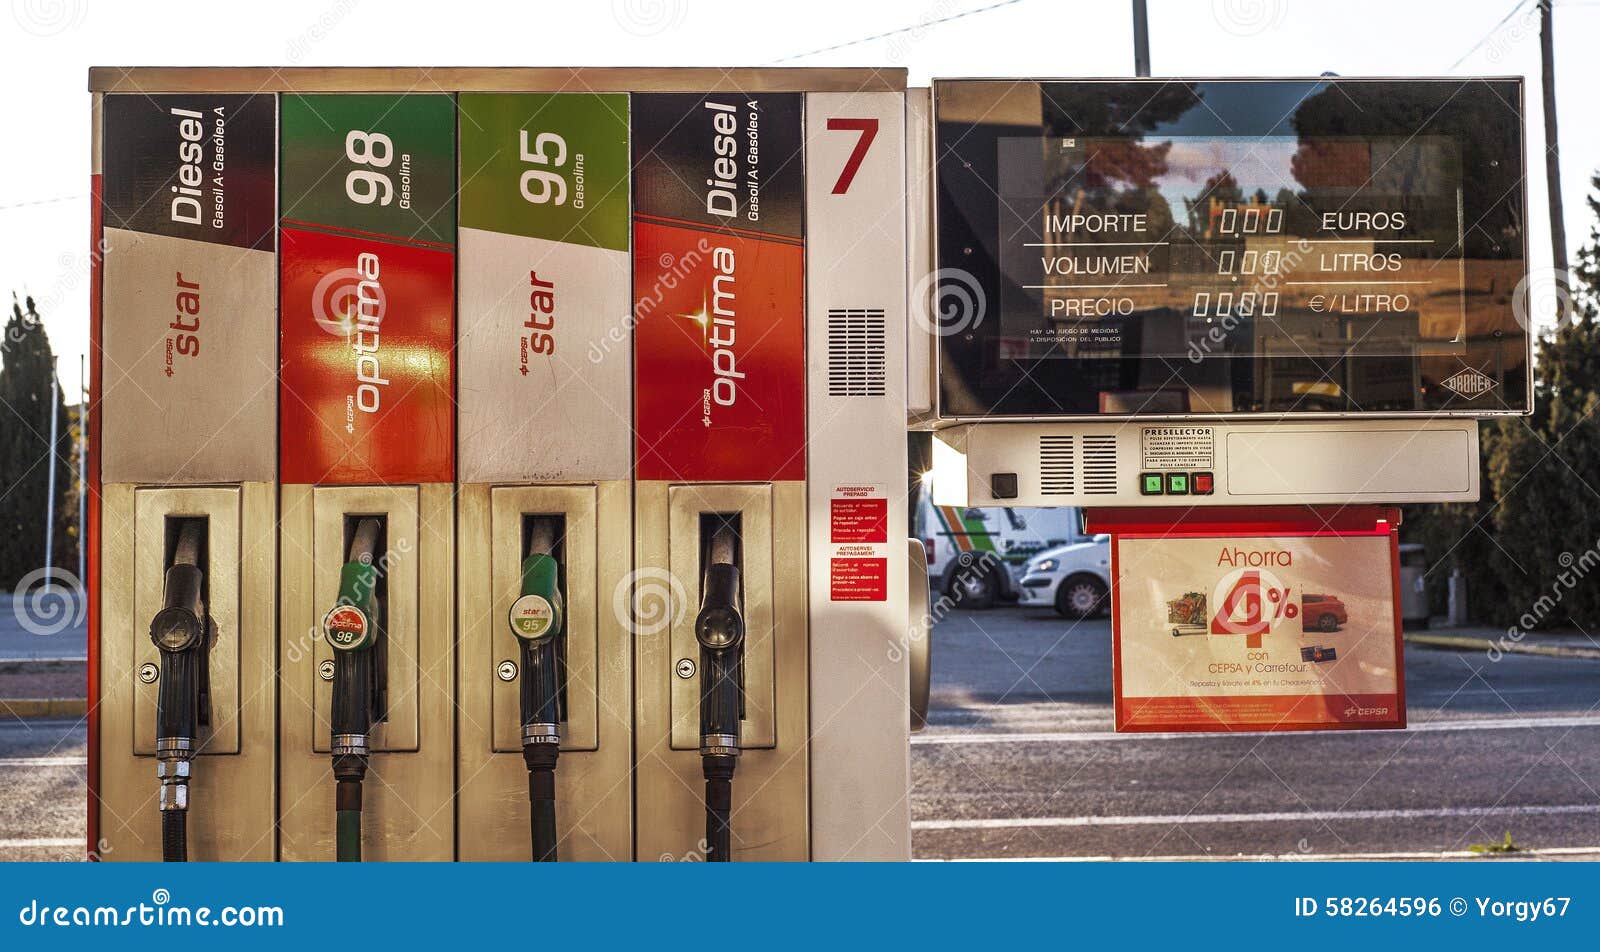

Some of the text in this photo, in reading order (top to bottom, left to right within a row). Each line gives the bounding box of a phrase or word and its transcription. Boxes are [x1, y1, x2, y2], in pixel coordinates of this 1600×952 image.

[213, 106, 225, 117] A
[748, 99, 759, 111] A
[171, 107, 203, 226] Diesel
[345, 129, 394, 207] 98
[519, 129, 568, 207] 95
[703, 101, 738, 219] Diesel
[826, 118, 880, 195] 7
[399, 153, 411, 210] Gasolina
[572, 152, 585, 210] Gasolina
[212, 187, 225, 230] Gasoil
[747, 181, 759, 222] Gasoil
[1045, 213, 1148, 233] IMPORTE
[1321, 211, 1406, 231] EUROS
[1040, 255, 1150, 276] VOLUMEN
[1320, 253, 1403, 272] LITROS
[170, 270, 201, 358] star
[524, 269, 555, 356] star
[1051, 297, 1135, 318] PRECIO
[352, 251, 390, 414] optima
[709, 246, 746, 407] optima
[166, 337, 174, 367] CEPSA
[520, 336, 529, 365] CEPSA
[702, 388, 711, 416] CEPSA
[1144, 428, 1211, 436] PRESELECTOR
[1217, 546, 1293, 567] Ahorra
[336, 630, 353, 643] 98
[522, 619, 539, 631] 95
[1208, 662, 1244, 674] CEPSA
[1245, 665, 1253, 676] y
[1246, 650, 1269, 661] con
[1357, 707, 1389, 716] CEPSA
